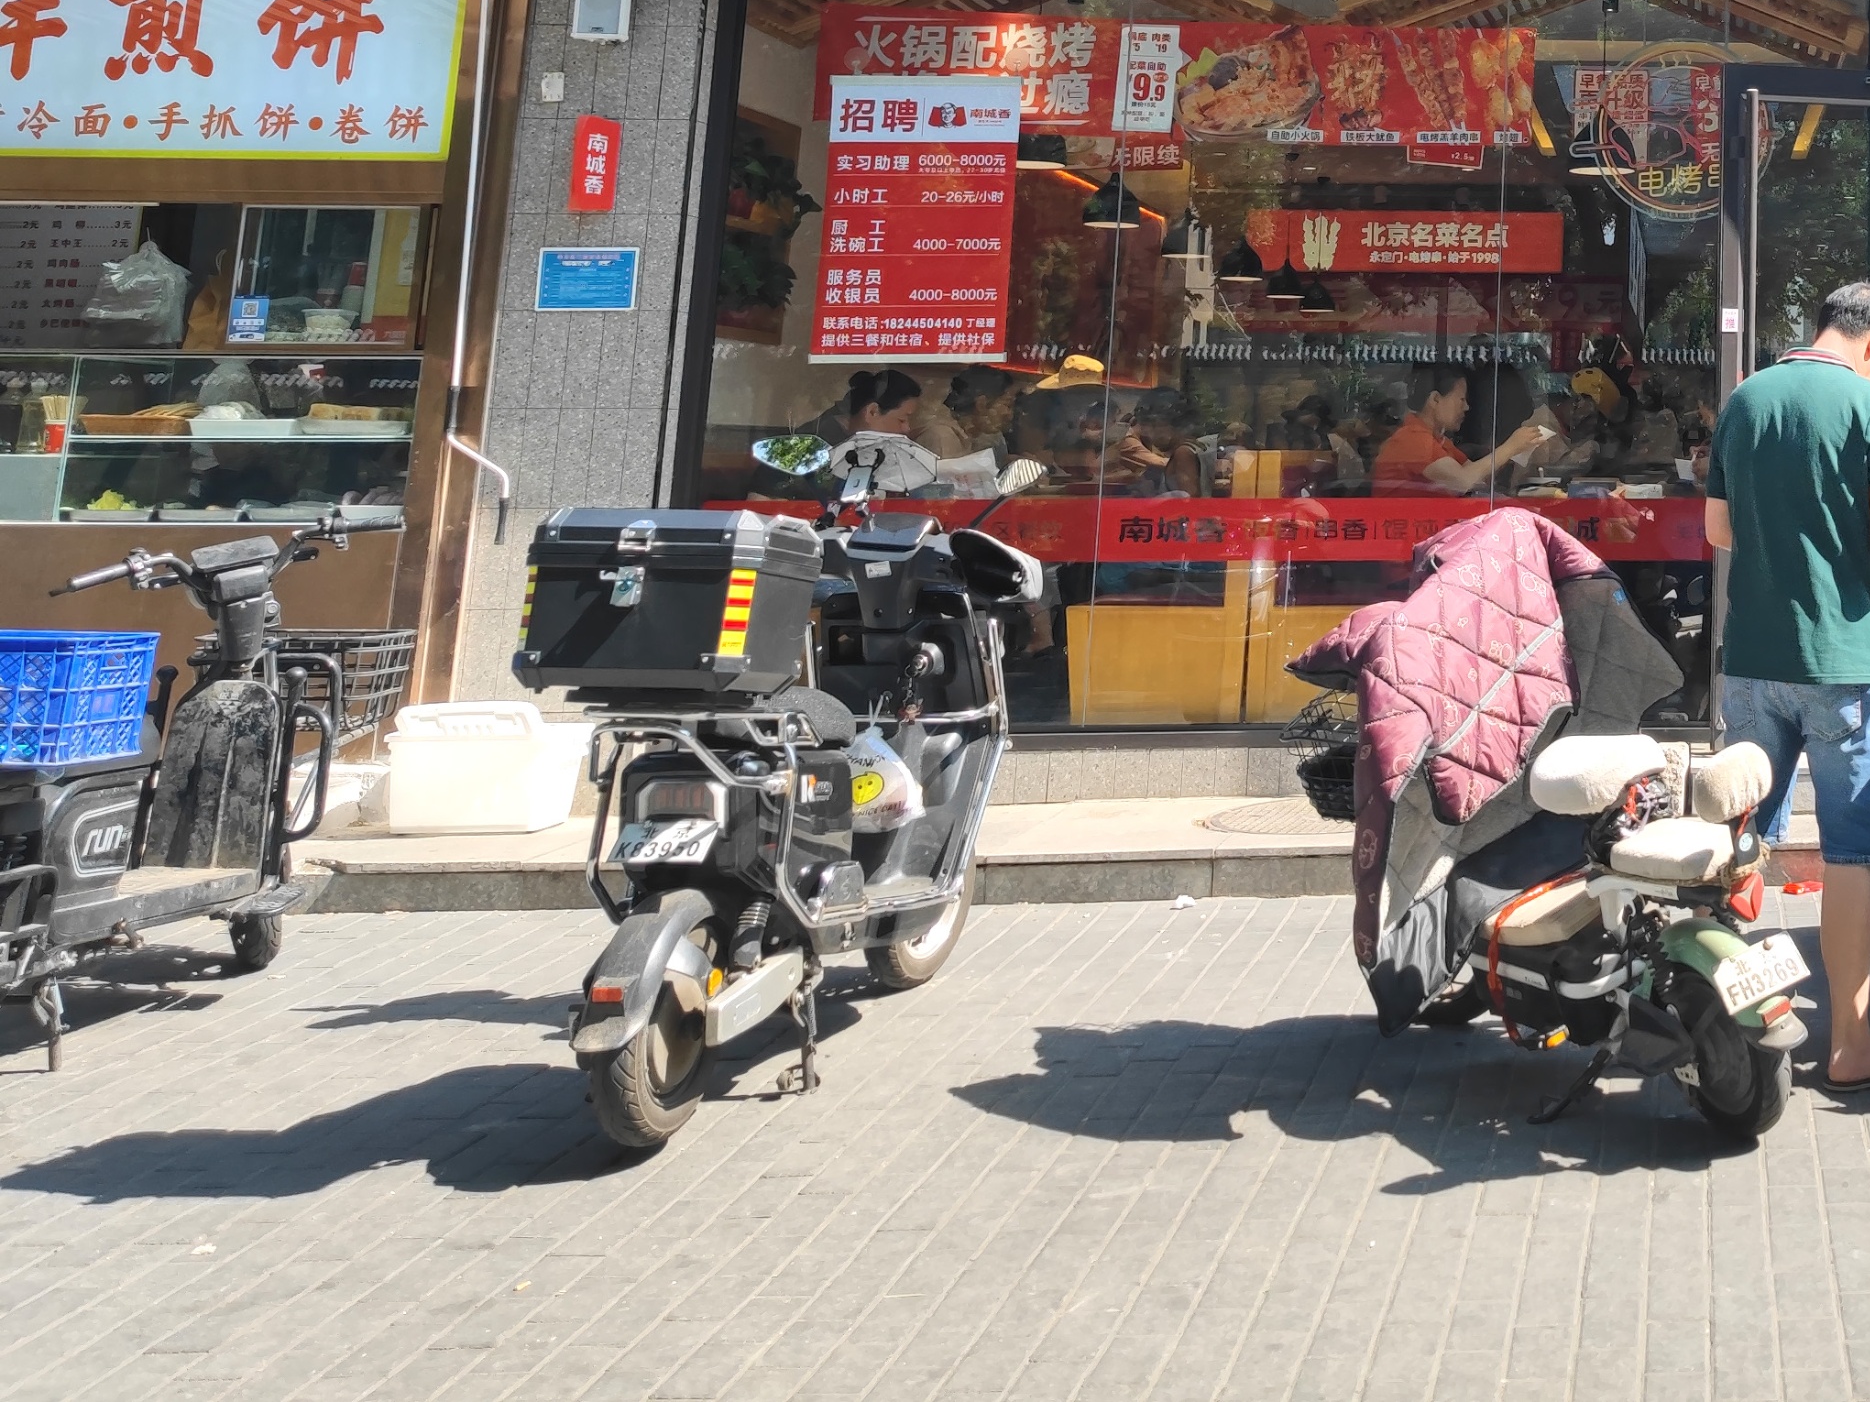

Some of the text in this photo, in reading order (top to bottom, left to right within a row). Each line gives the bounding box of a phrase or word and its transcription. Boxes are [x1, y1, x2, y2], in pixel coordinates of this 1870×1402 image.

[855, 23, 1096, 69] 火锅配烧烤
[839, 98, 919, 134] 招聘
[969, 108, 1012, 119] 南城香
[1270, 130, 1321, 142] 自助小火锅
[1345, 131, 1395, 142] 铁板大鱿鱼
[584, 133, 609, 195] 南城香
[837, 154, 1006, 171] 实习助理 6000-8000元
[834, 188, 1004, 204] 小时工 20-26元/小时
[1361, 221, 1509, 248] 北京名菜名点
[829, 237, 1001, 253] 洗碗工 4000-7000元
[826, 269, 882, 286] 服务员
[825, 288, 998, 304] 收银员 4000-8000元
[821, 333, 996, 348] 提供三餐和住宿、提供社保
[1119, 516, 1225, 544] 南城香
[616, 841, 700, 859] K83950
[1726, 958, 1800, 1006] FH3269
